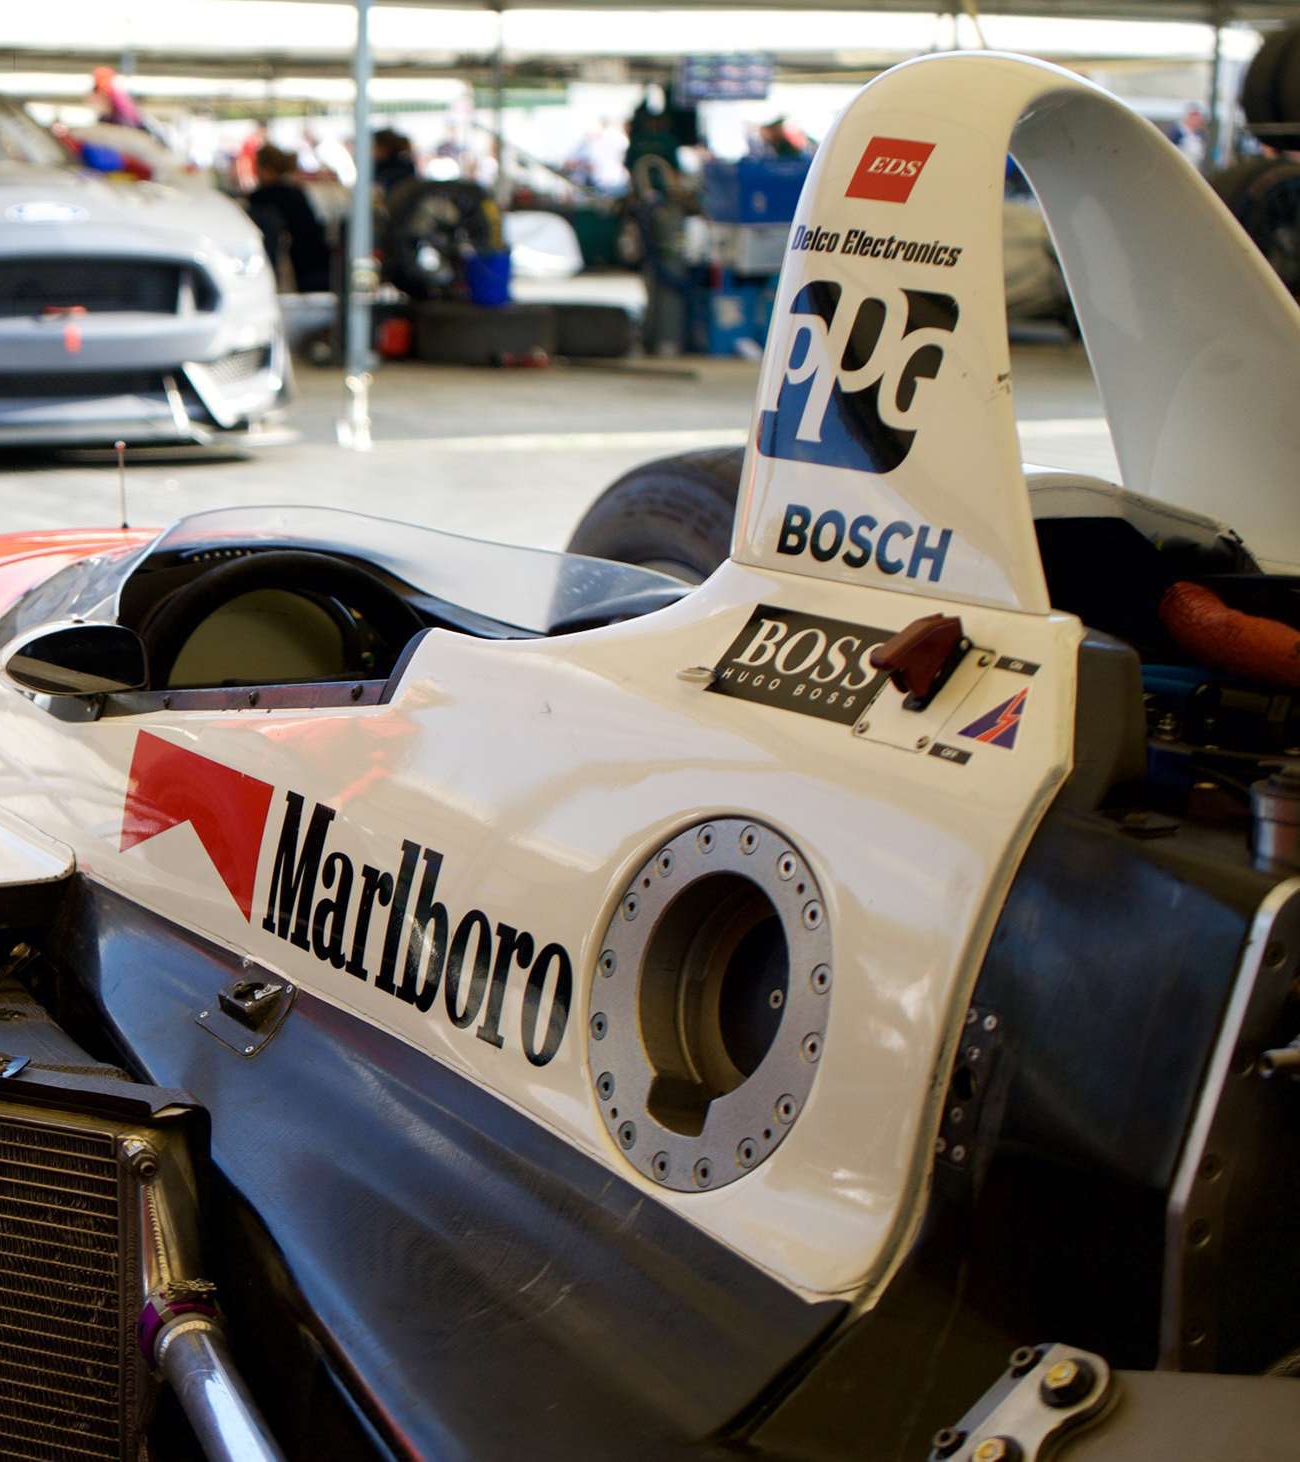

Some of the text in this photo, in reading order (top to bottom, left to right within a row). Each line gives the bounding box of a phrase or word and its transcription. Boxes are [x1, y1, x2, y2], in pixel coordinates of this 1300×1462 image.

[867, 156, 922, 177] EDS
[790, 224, 963, 267] Delco Electronics
[776, 503, 953, 583] BOSCH
[732, 618, 886, 690] BOSS
[722, 667, 856, 708] HUGO BOSS
[262, 790, 573, 1067] Marlboro
